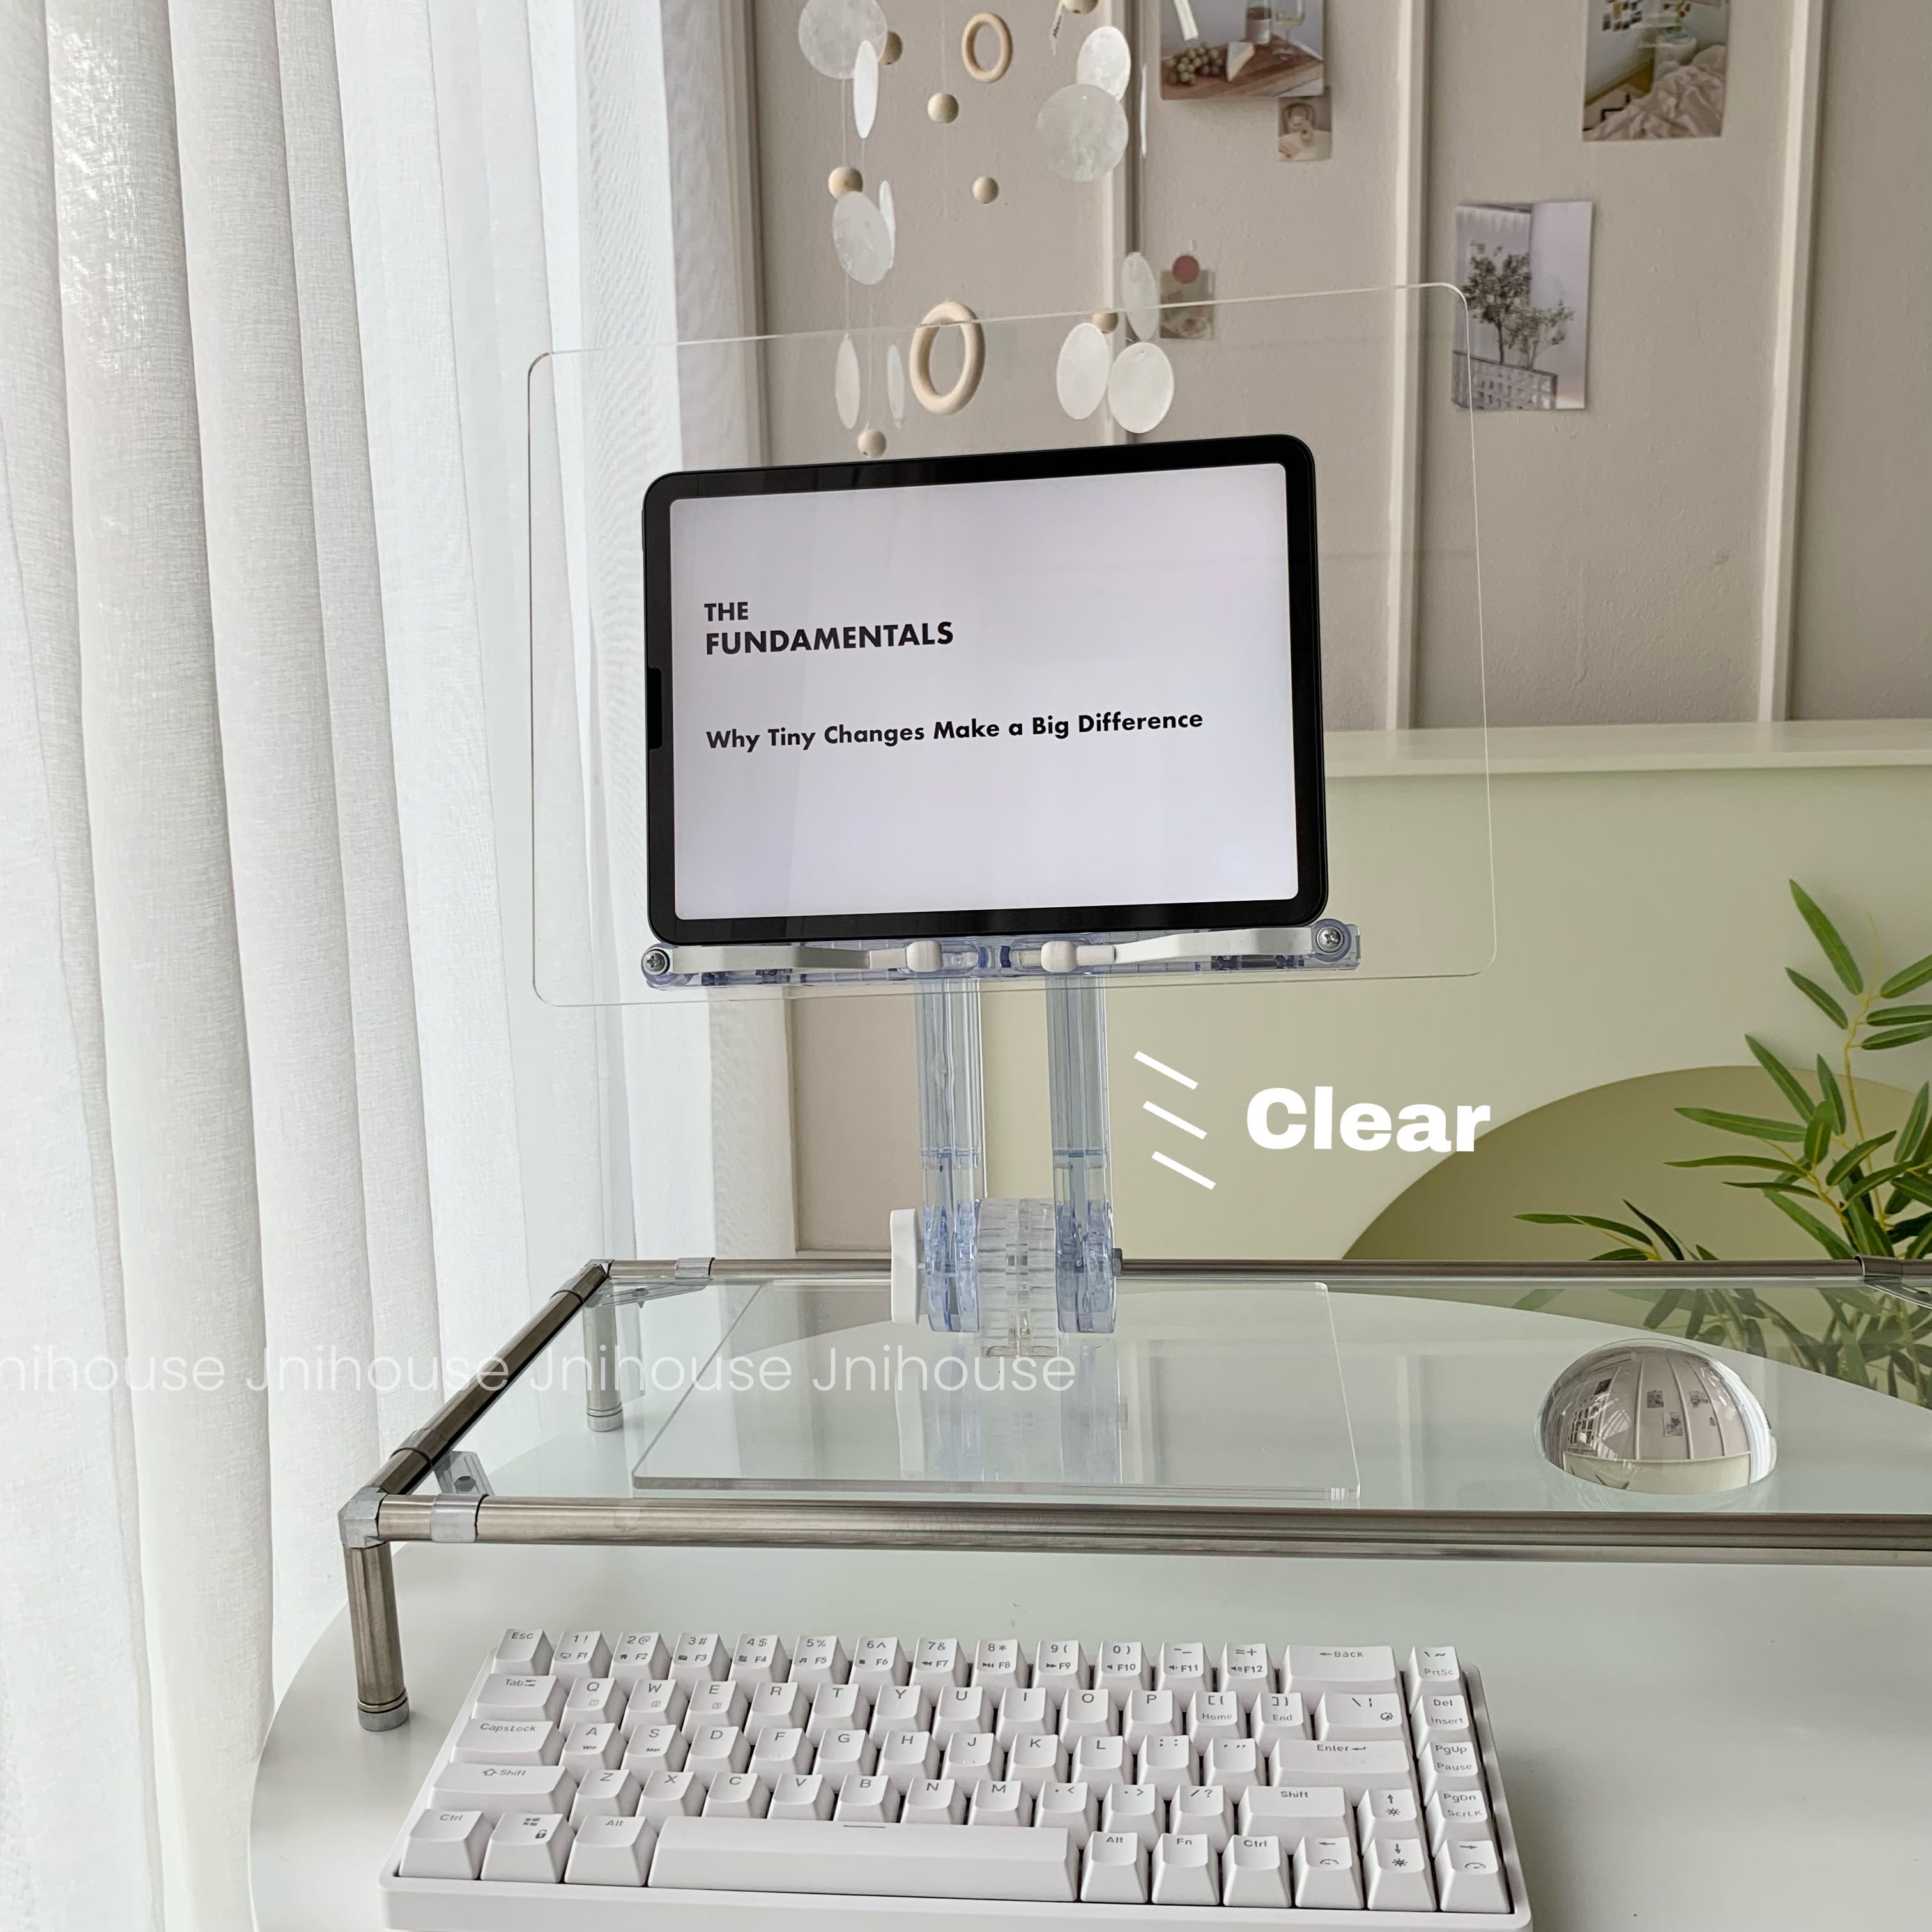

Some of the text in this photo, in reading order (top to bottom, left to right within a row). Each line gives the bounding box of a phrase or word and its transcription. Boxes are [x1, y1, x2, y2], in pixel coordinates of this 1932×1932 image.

[704, 602, 749, 622] THE
[705, 621, 953, 656] FUNDAMENTALS
[705, 711, 1203, 753] Why Tiny Changes Make a Big Difference
[510, 1632, 534, 1640] Esc
[576, 1652, 588, 1660] F1
[634, 1652, 648, 1660] F2
[694, 1653, 707, 1662] F3
[754, 1655, 767, 1664] F4
[814, 1656, 827, 1664] F5
[875, 1657, 889, 1666] F6
[935, 1659, 949, 1668] F7
[998, 1660, 1011, 1669] F8
[1059, 1662, 1071, 1670] F9
[1117, 1663, 1136, 1671] F10
[1181, 1664, 1198, 1673] F11
[1243, 1665, 1263, 1674] F12
[505, 1678, 524, 1687] Tab
[586, 1682, 600, 1692] Q
[648, 1682, 663, 1693] W
[708, 1684, 721, 1695] E
[770, 1686, 783, 1696] R
[832, 1687, 844, 1698] T
[894, 1689, 907, 1699] Y
[956, 1690, 968, 1701] U
[1081, 1693, 1094, 1704] O
[1146, 1694, 1158, 1705] P
[1433, 1699, 1453, 1707] Del
[1430, 1716, 1464, 1724] Insert
[585, 1727, 597, 1736] A
[648, 1728, 660, 1738] S
[710, 1729, 724, 1740] D
[774, 1731, 786, 1742] F
[838, 1733, 850, 1744] G
[901, 1735, 914, 1745] H
[967, 1736, 977, 1747] J
[1029, 1738, 1042, 1749] K
[1096, 1740, 1106, 1750] L
[1317, 1744, 1349, 1752] Enter
[1435, 1744, 1468, 1755] PgUp
[499, 1767, 526, 1776] Shift
[1437, 1762, 1473, 1771] Pause
[599, 1772, 614, 1782] Z
[664, 1774, 678, 1784] X
[729, 1776, 742, 1786] C
[795, 1777, 808, 1787] V
[859, 1779, 872, 1788] B
[926, 1782, 940, 1791] N
[991, 1784, 1007, 1794] M
[1443, 1793, 1476, 1803] PgDn
[1243, 1839, 1267, 1848] Ctrl
